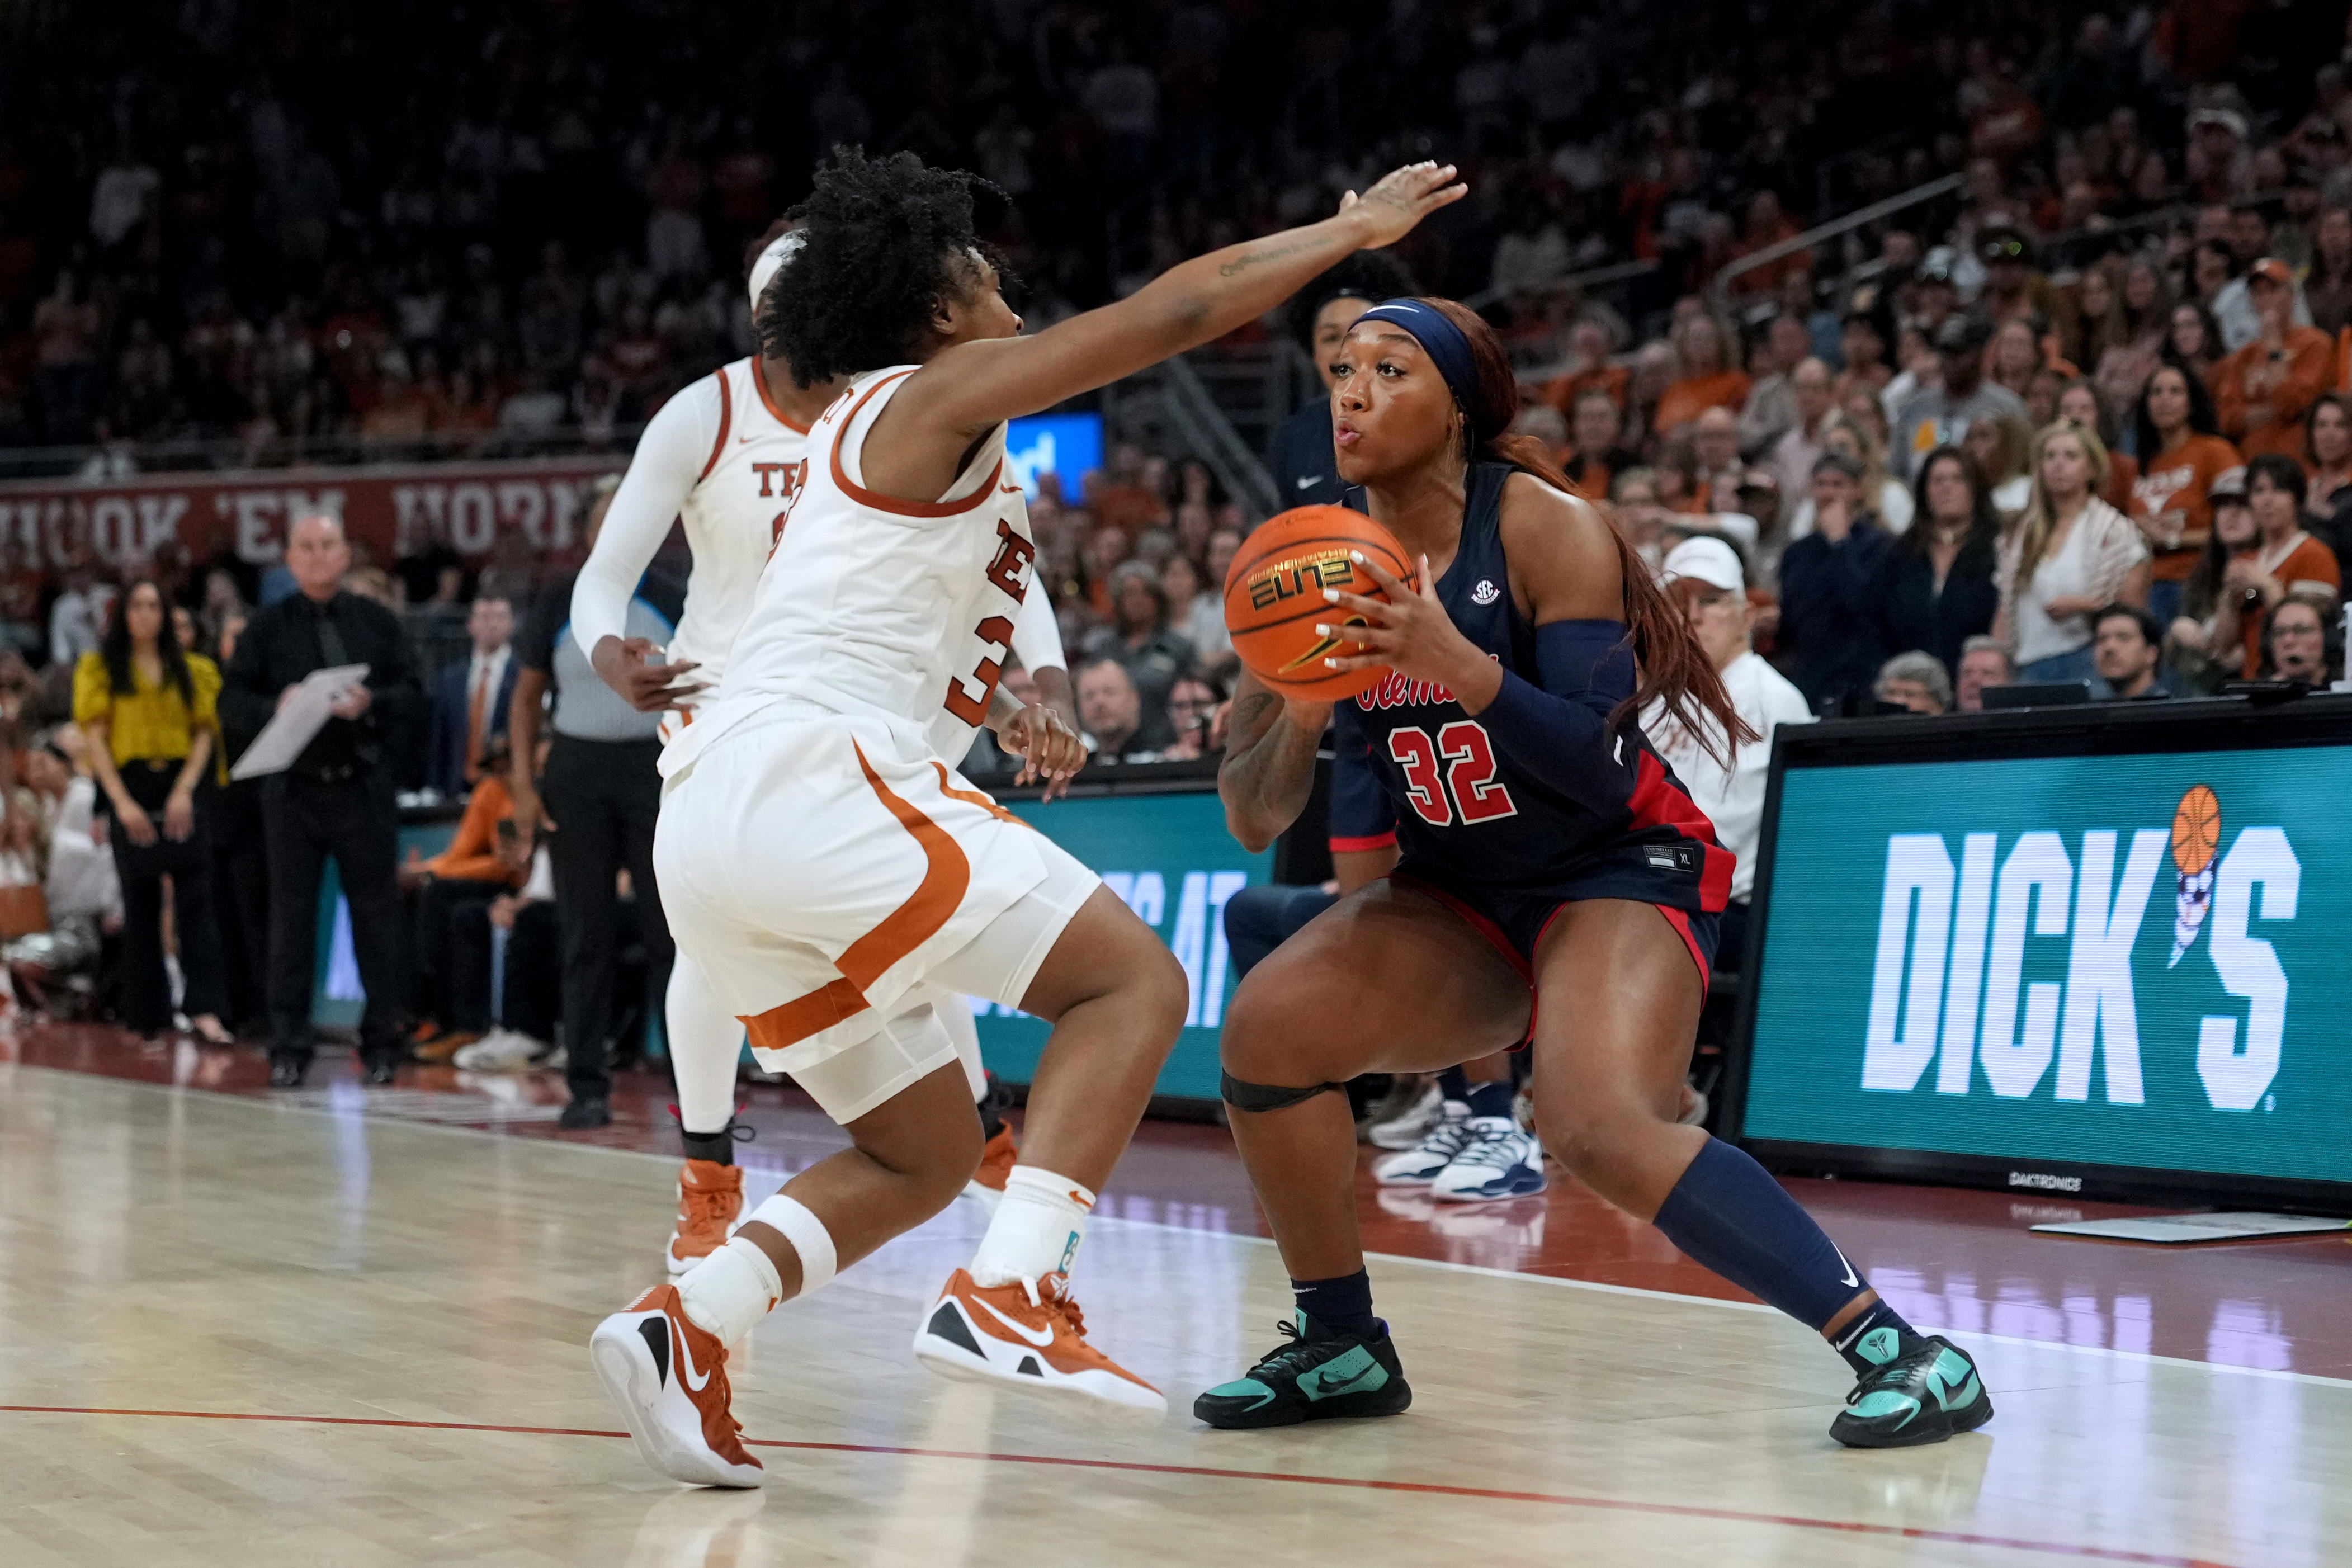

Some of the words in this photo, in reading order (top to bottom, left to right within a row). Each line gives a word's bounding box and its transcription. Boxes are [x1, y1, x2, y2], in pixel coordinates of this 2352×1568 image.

[1249, 555, 1354, 611] ELITE
[1476, 580, 1494, 599] SEC
[1388, 720, 1518, 826] 32
[1680, 853, 1690, 865] XL
[1861, 785, 2302, 1113] DICK'S
[2008, 1171, 2082, 1192] DAKTRONICS
